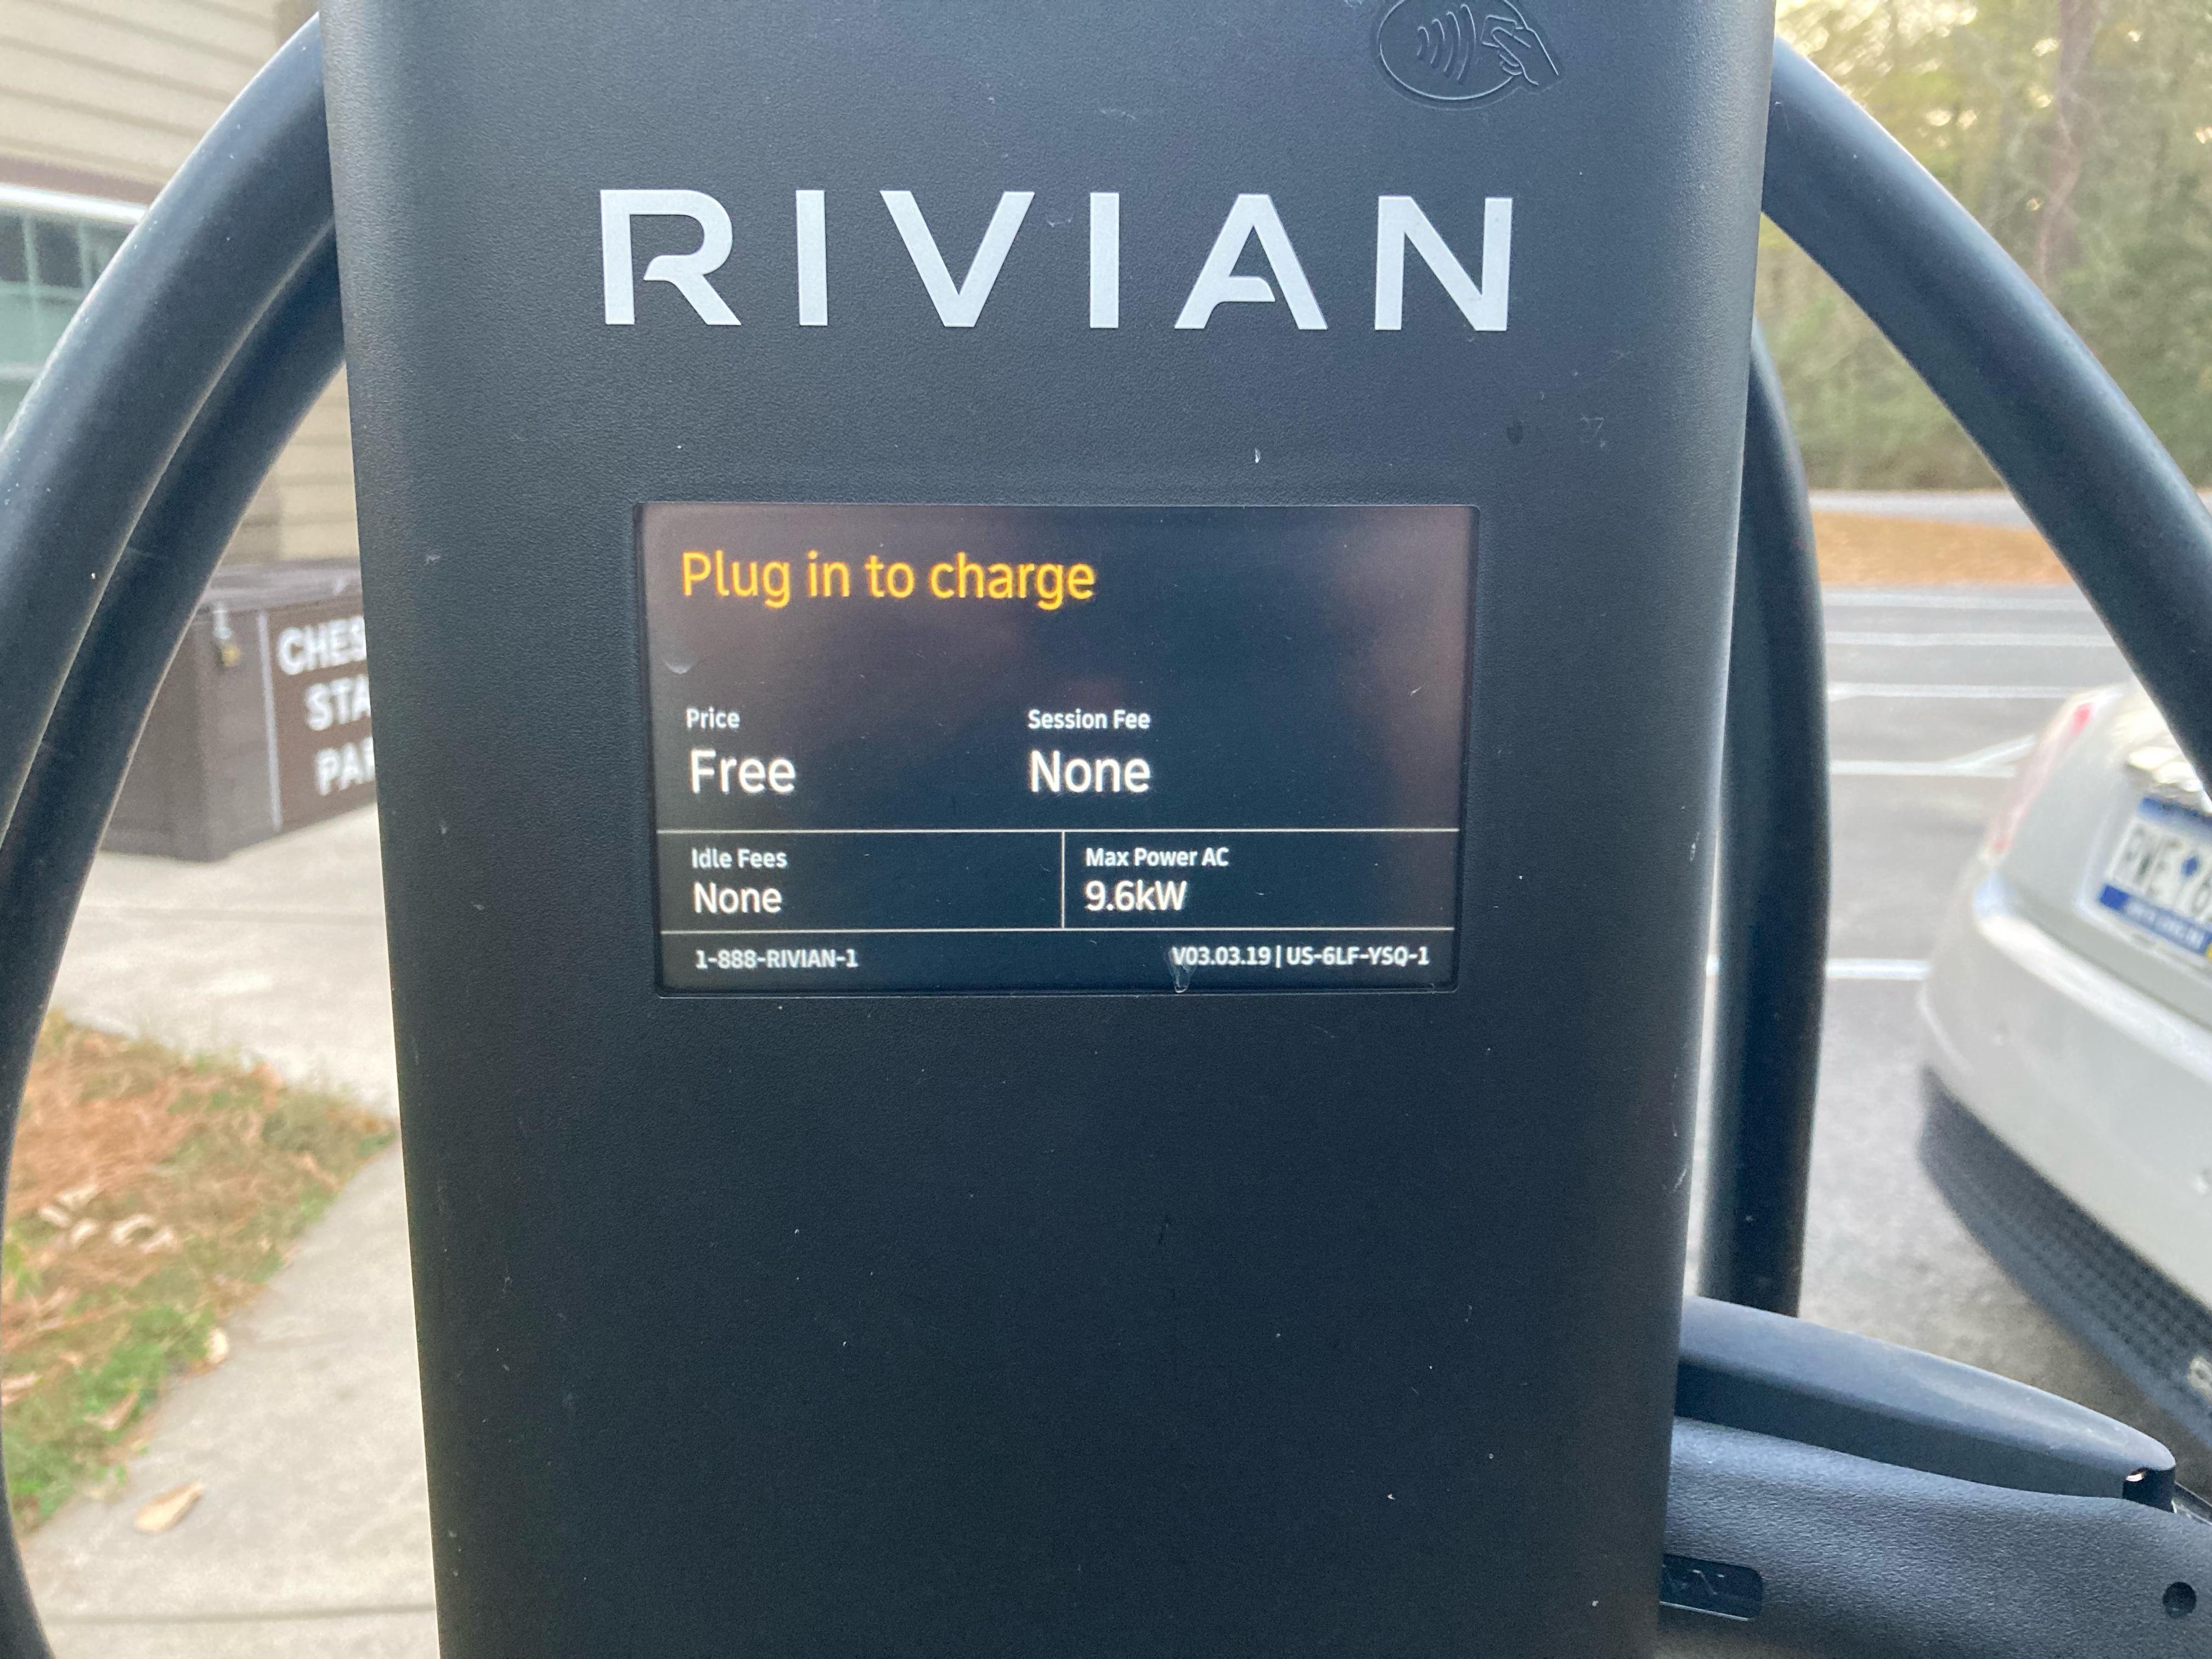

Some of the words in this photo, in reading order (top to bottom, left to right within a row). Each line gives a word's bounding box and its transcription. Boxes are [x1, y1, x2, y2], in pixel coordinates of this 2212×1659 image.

[600, 189, 1513, 331] RIVIAN
[681, 549, 791, 609] Plug
[807, 550, 850, 597] in
[864, 555, 916, 599] to
[928, 551, 1094, 611] charge
[686, 706, 740, 729] Price
[1028, 708, 1108, 729] Session
[1113, 709, 1151, 730] Fee
[690, 748, 795, 794] Free
[1029, 749, 1150, 793] None
[691, 848, 732, 869] Idle
[737, 848, 787, 868] Fees
[1085, 848, 1129, 867] Max
[1133, 847, 1198, 867] Power
[1201, 847, 1229, 867] AC
[693, 882, 782, 914] None
[1085, 879, 1187, 911] 9.6kW
[696, 949, 858, 969] 1-888-RIVIAN-1
